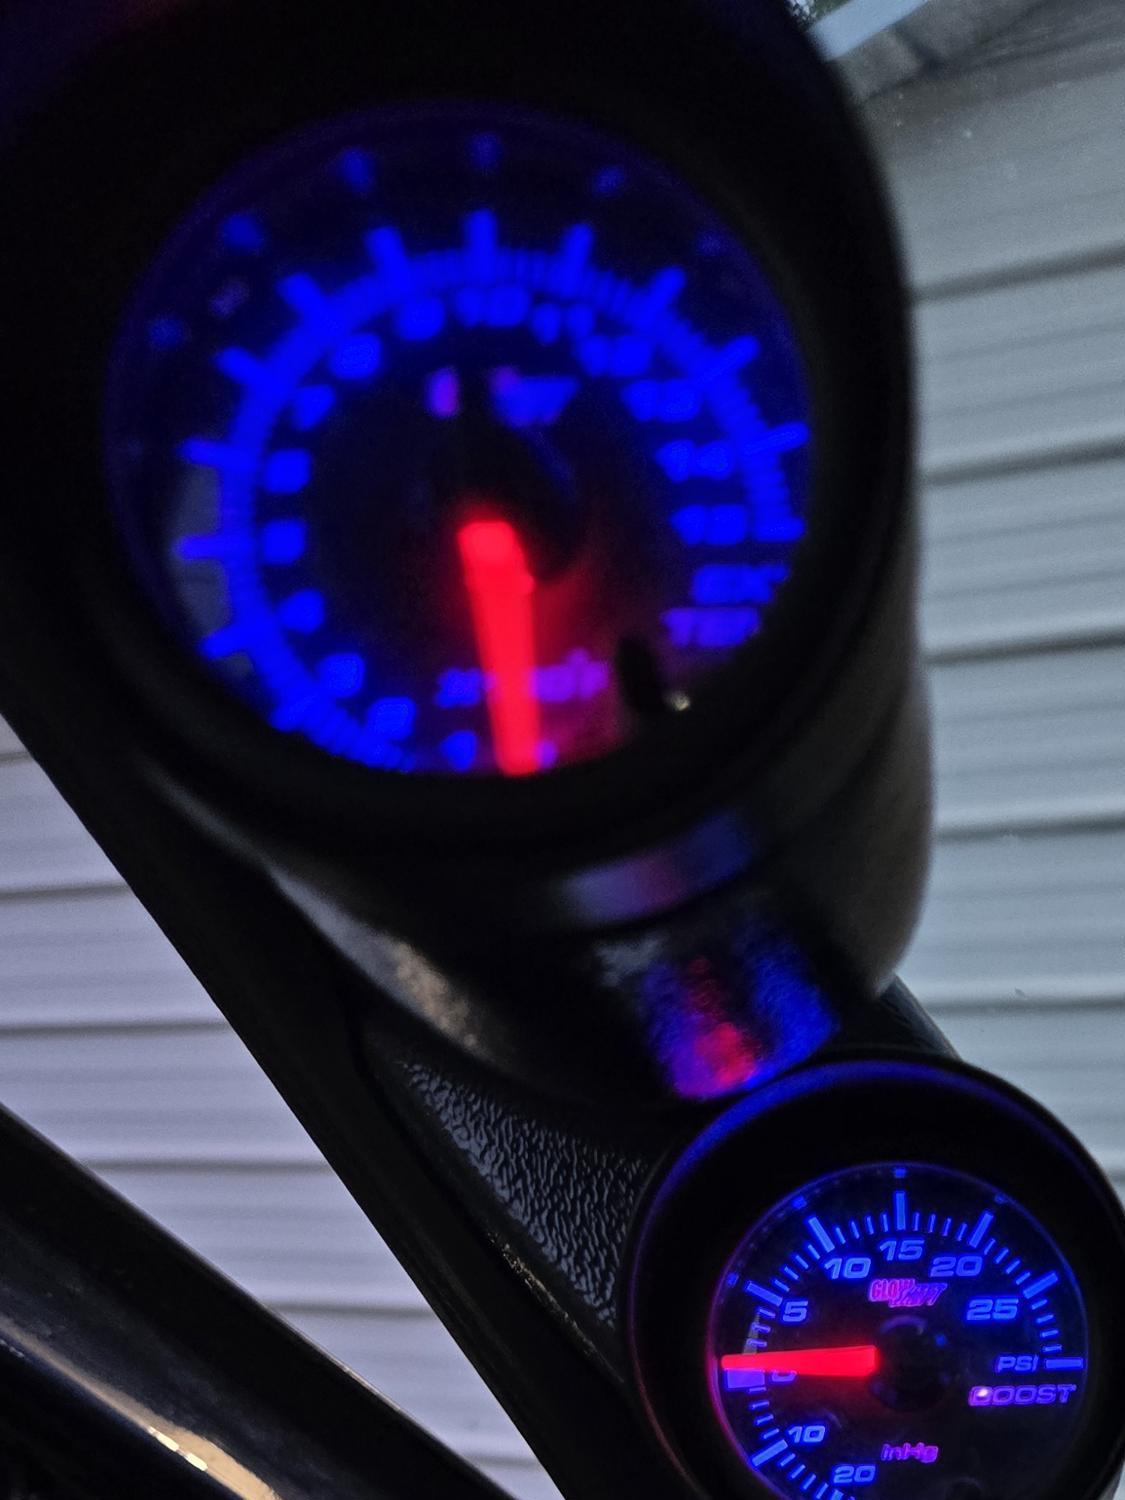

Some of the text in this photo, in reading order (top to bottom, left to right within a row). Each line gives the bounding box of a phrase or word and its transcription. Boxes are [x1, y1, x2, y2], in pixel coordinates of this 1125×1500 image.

[879, 1239, 924, 1261] 15
[823, 1257, 871, 1279] 10
[929, 1256, 982, 1277] 20
[782, 1300, 808, 1322] 5
[966, 1298, 1018, 1321] 25
[995, 1356, 1039, 1374] PSI
[968, 1384, 1077, 1407] BOOST
[787, 1425, 827, 1444] 10
[833, 1464, 877, 1484] 20
